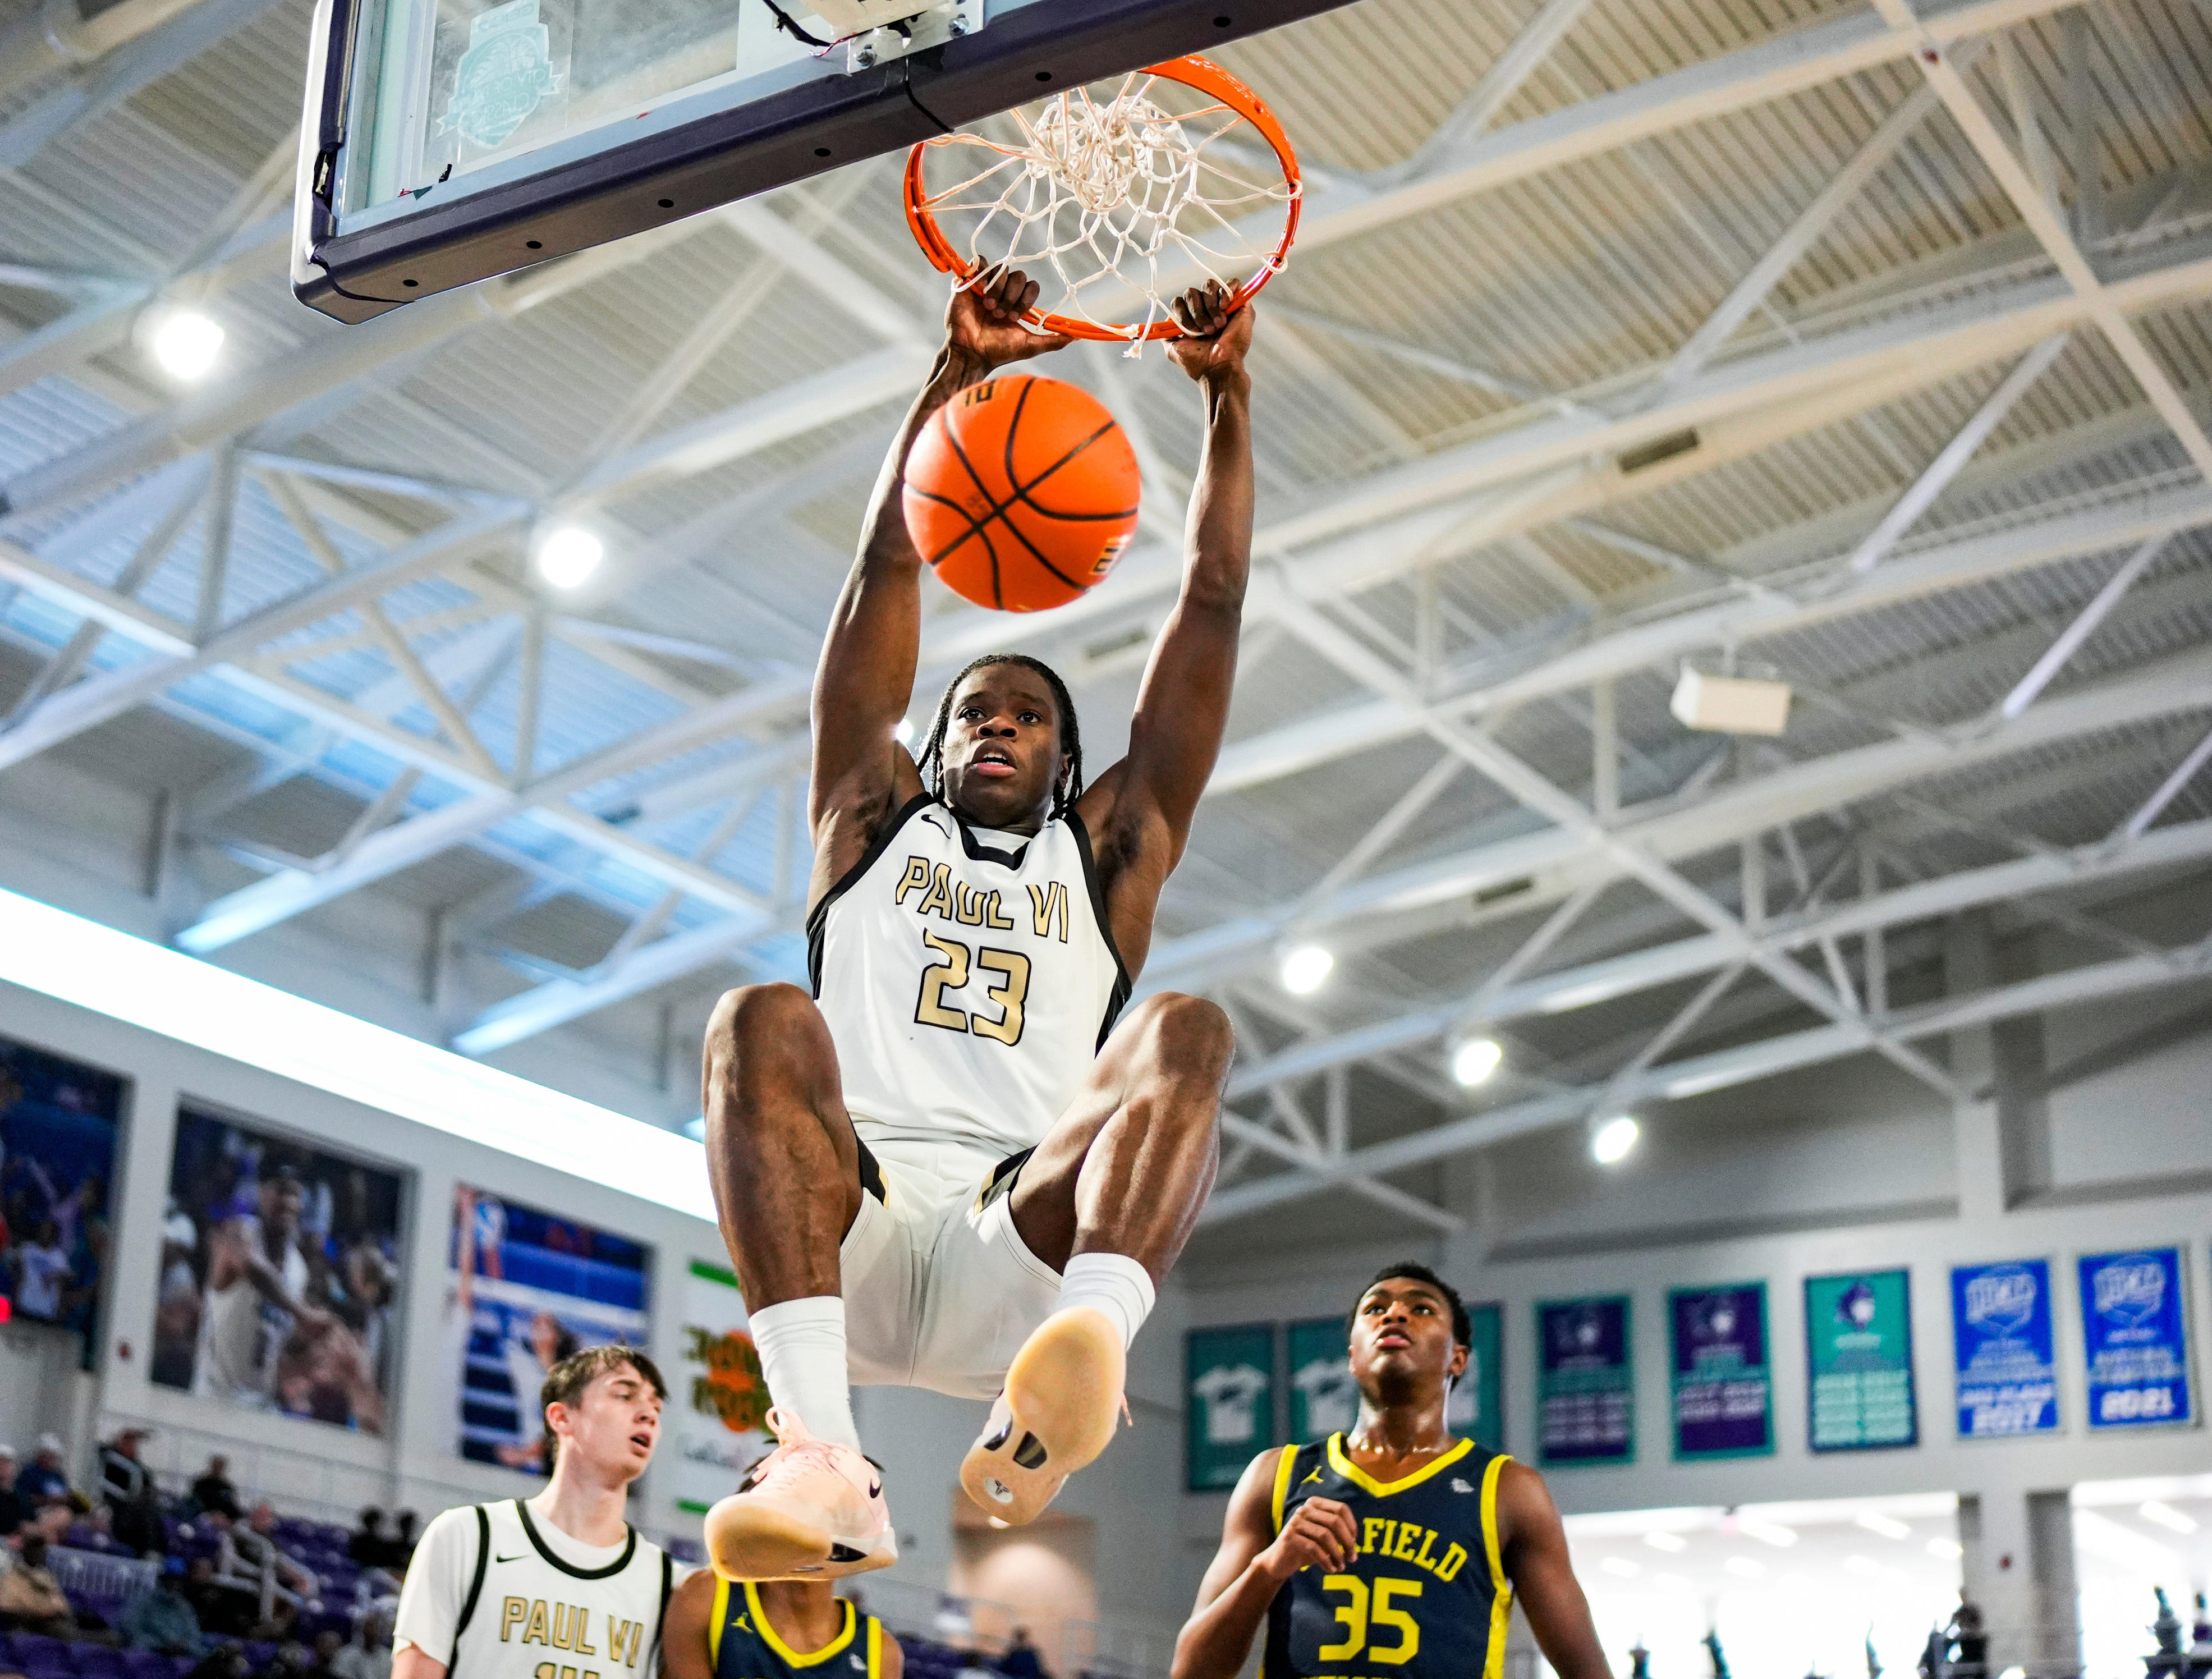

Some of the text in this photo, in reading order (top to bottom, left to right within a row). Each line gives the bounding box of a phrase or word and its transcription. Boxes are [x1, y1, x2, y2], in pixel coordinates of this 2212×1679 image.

[896, 855, 1068, 944] PAUL VI
[914, 927, 1031, 1047] 23
[1299, 1517, 1468, 1582] FIELD
[501, 1596, 643, 1668] PAUL VI
[1319, 1575, 1423, 1665] 35
